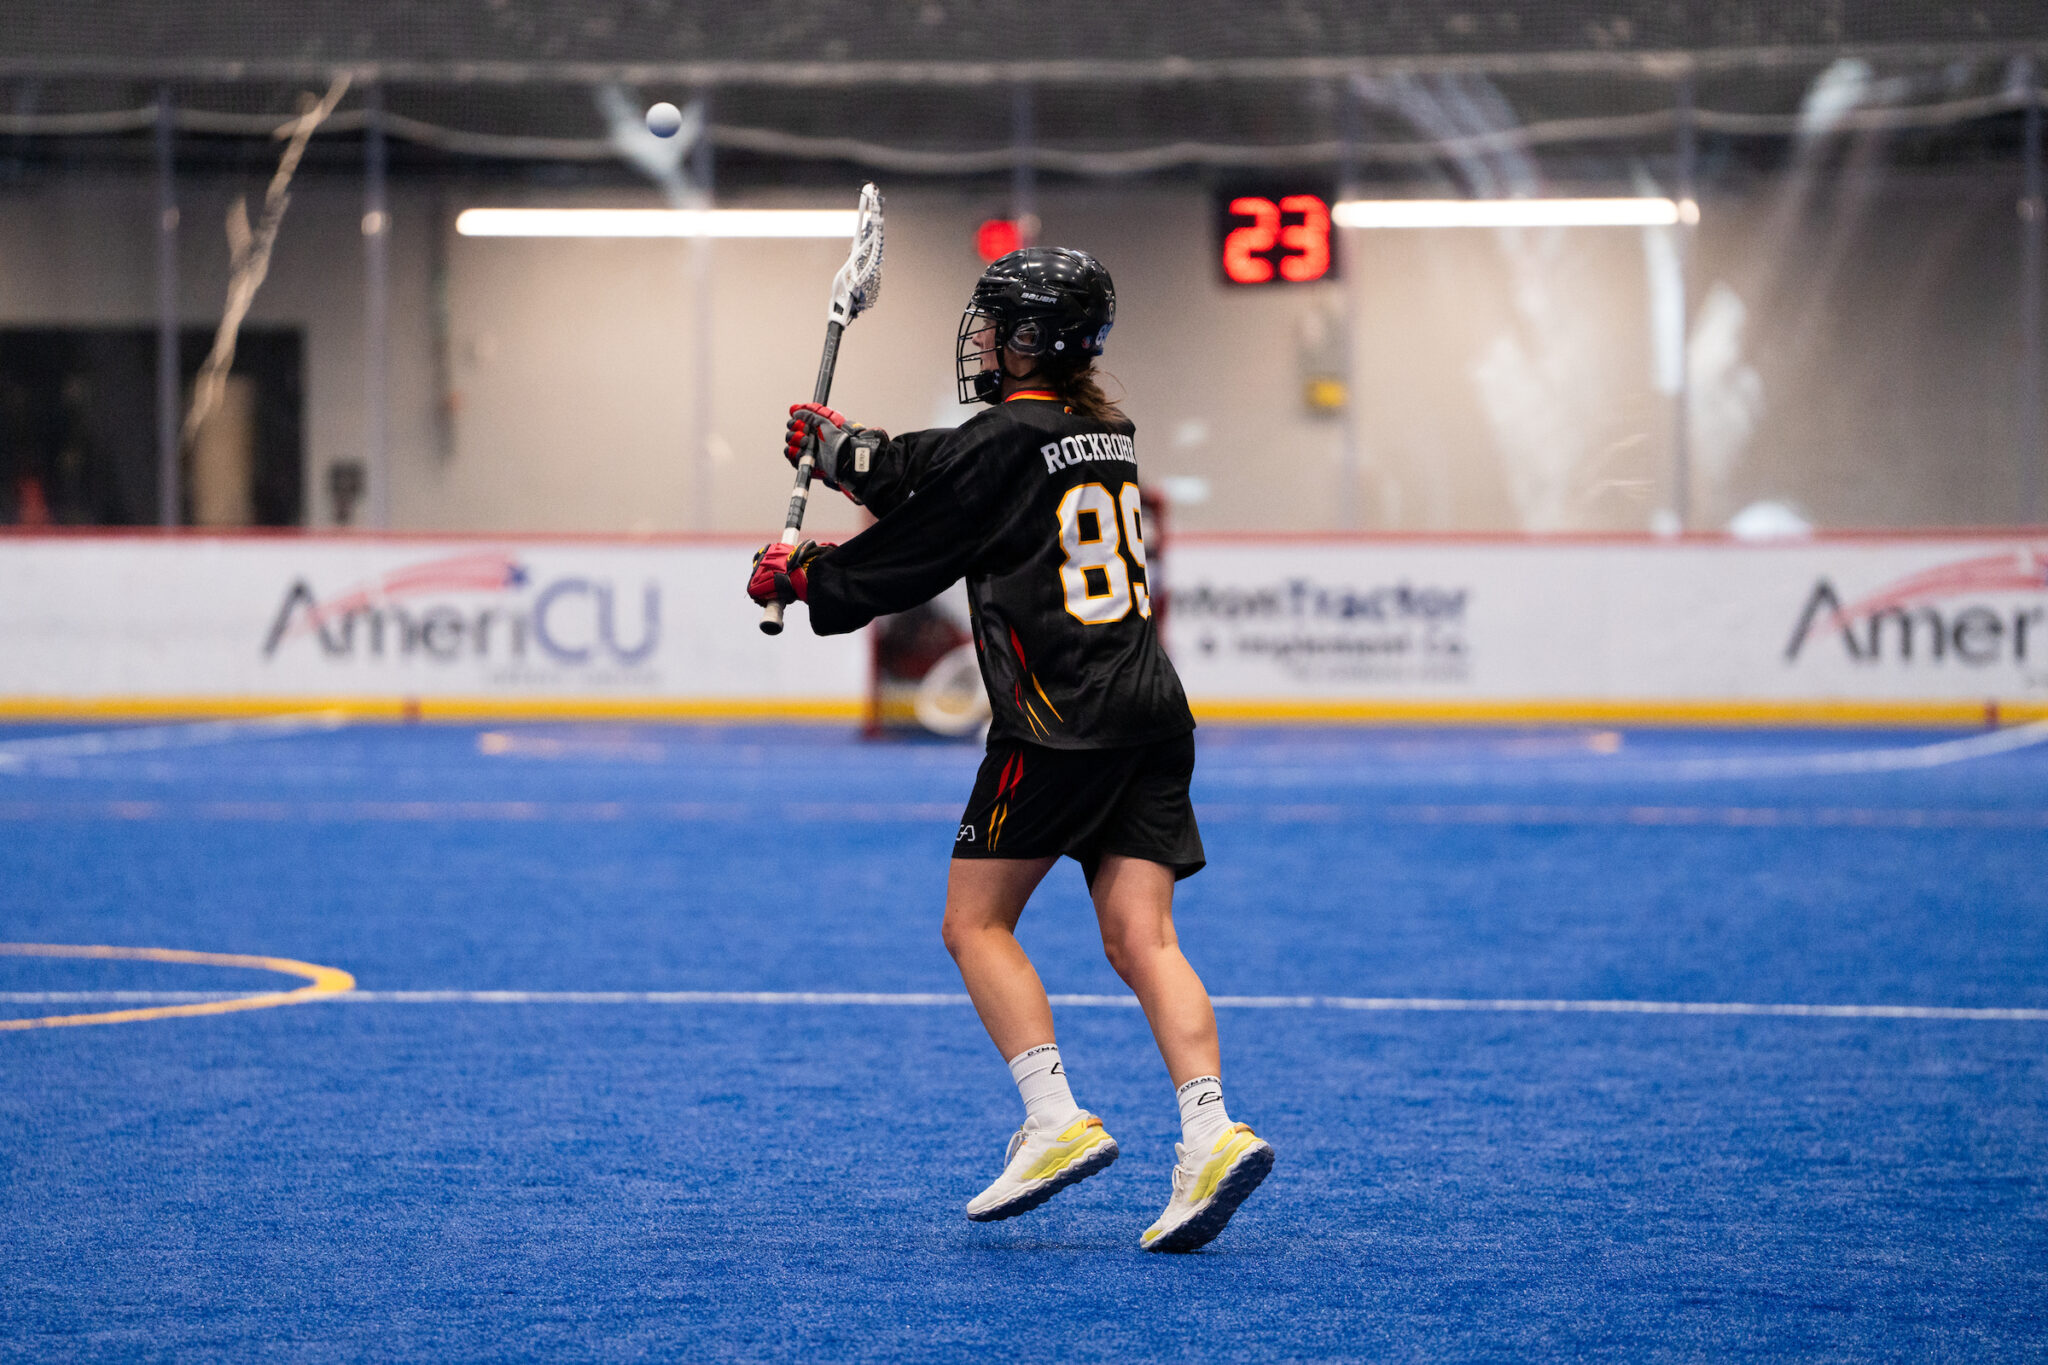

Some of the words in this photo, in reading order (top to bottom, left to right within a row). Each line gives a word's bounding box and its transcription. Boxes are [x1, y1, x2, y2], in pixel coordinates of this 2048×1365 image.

[1224, 194, 1331, 283] 23
[1021, 292, 1057, 304] BAUER
[1056, 481, 1151, 625] 89
[262, 576, 662, 665] AmeriCU
[1784, 577, 2046, 666] Amer
